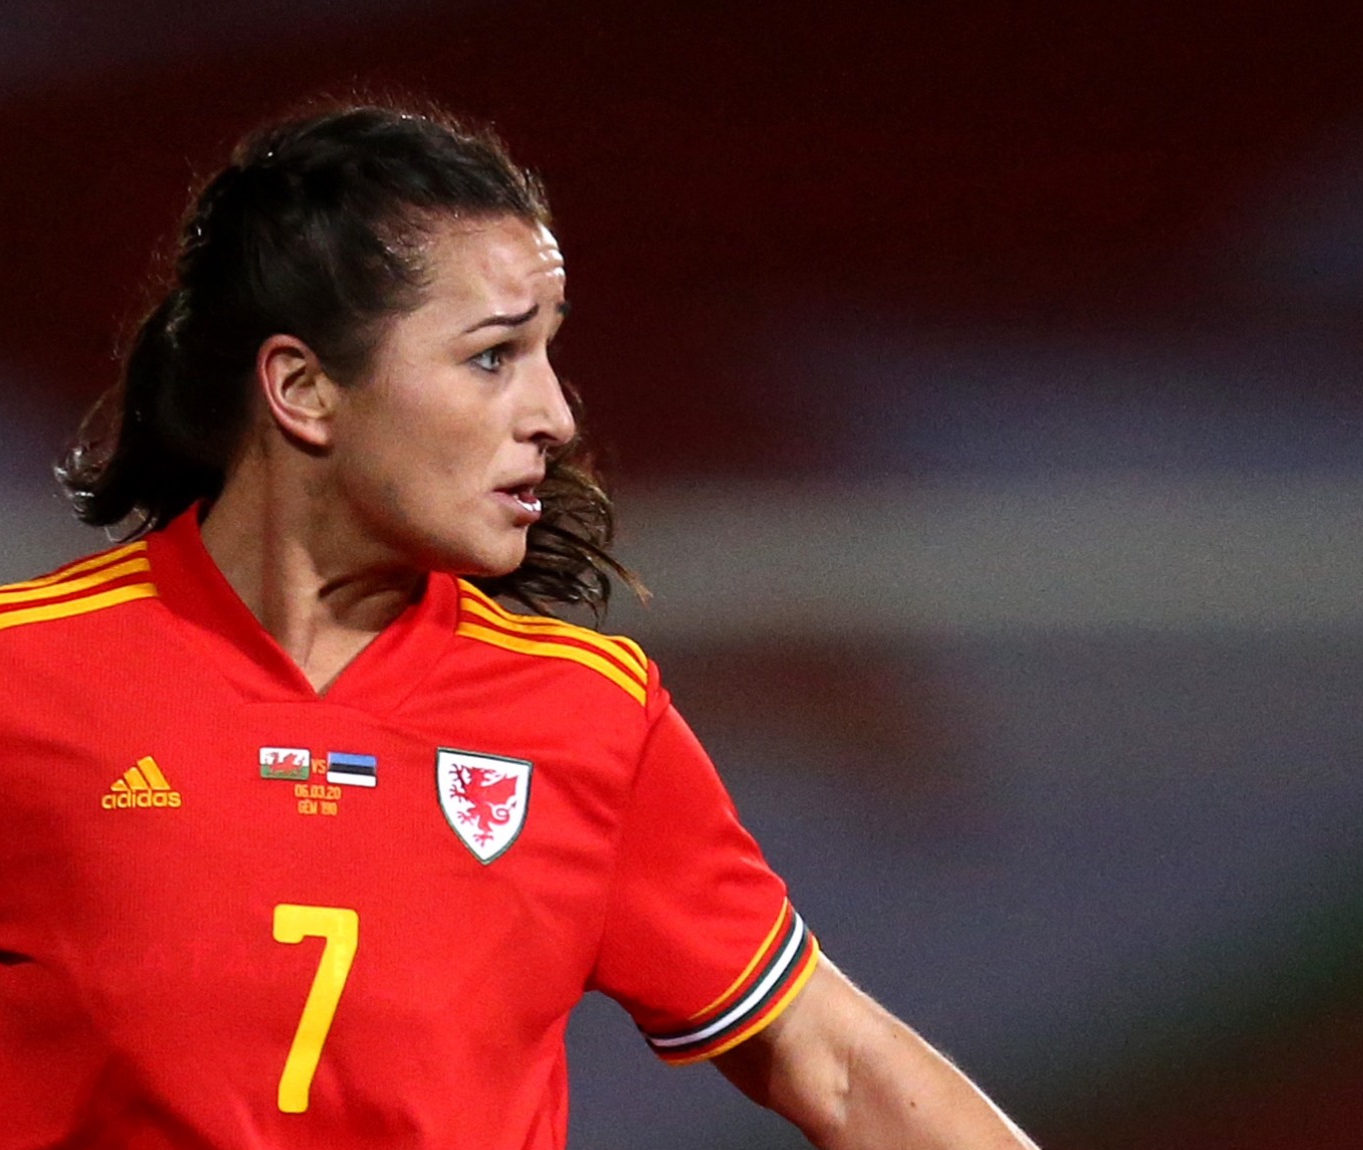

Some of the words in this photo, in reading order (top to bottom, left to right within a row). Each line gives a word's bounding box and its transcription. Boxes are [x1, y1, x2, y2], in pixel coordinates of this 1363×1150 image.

[311, 758, 326, 774] VS
[101, 789, 182, 810] adidas
[273, 903, 360, 1114] 7
